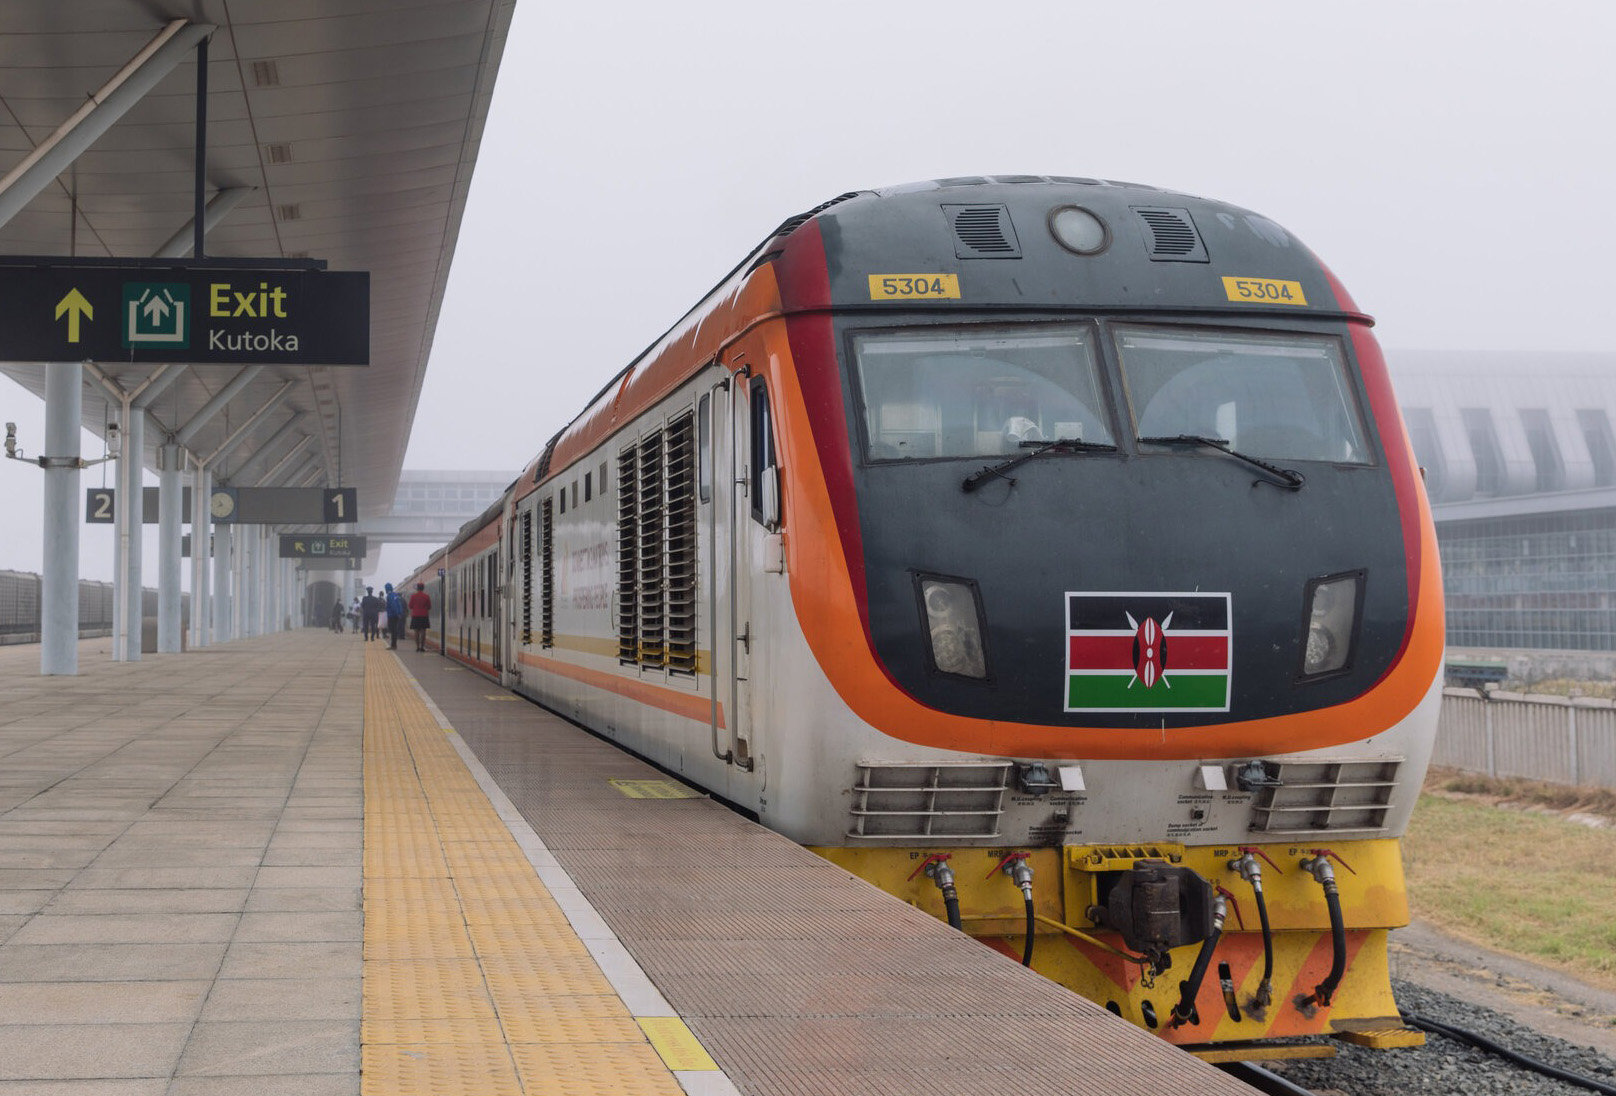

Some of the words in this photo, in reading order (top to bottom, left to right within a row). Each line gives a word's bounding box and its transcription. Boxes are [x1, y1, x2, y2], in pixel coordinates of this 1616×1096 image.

[882, 277, 945, 295] 5304
[1236, 281, 1294, 300] 5304
[210, 282, 287, 318] Exit
[209, 328, 299, 351] Kutoka
[94, 493, 111, 518] 2
[332, 493, 343, 518] 1
[329, 539, 349, 548] Exit
[909, 852, 919, 860] EP
[1214, 849, 1229, 857] MRP
[1288, 848, 1298, 856] EP
